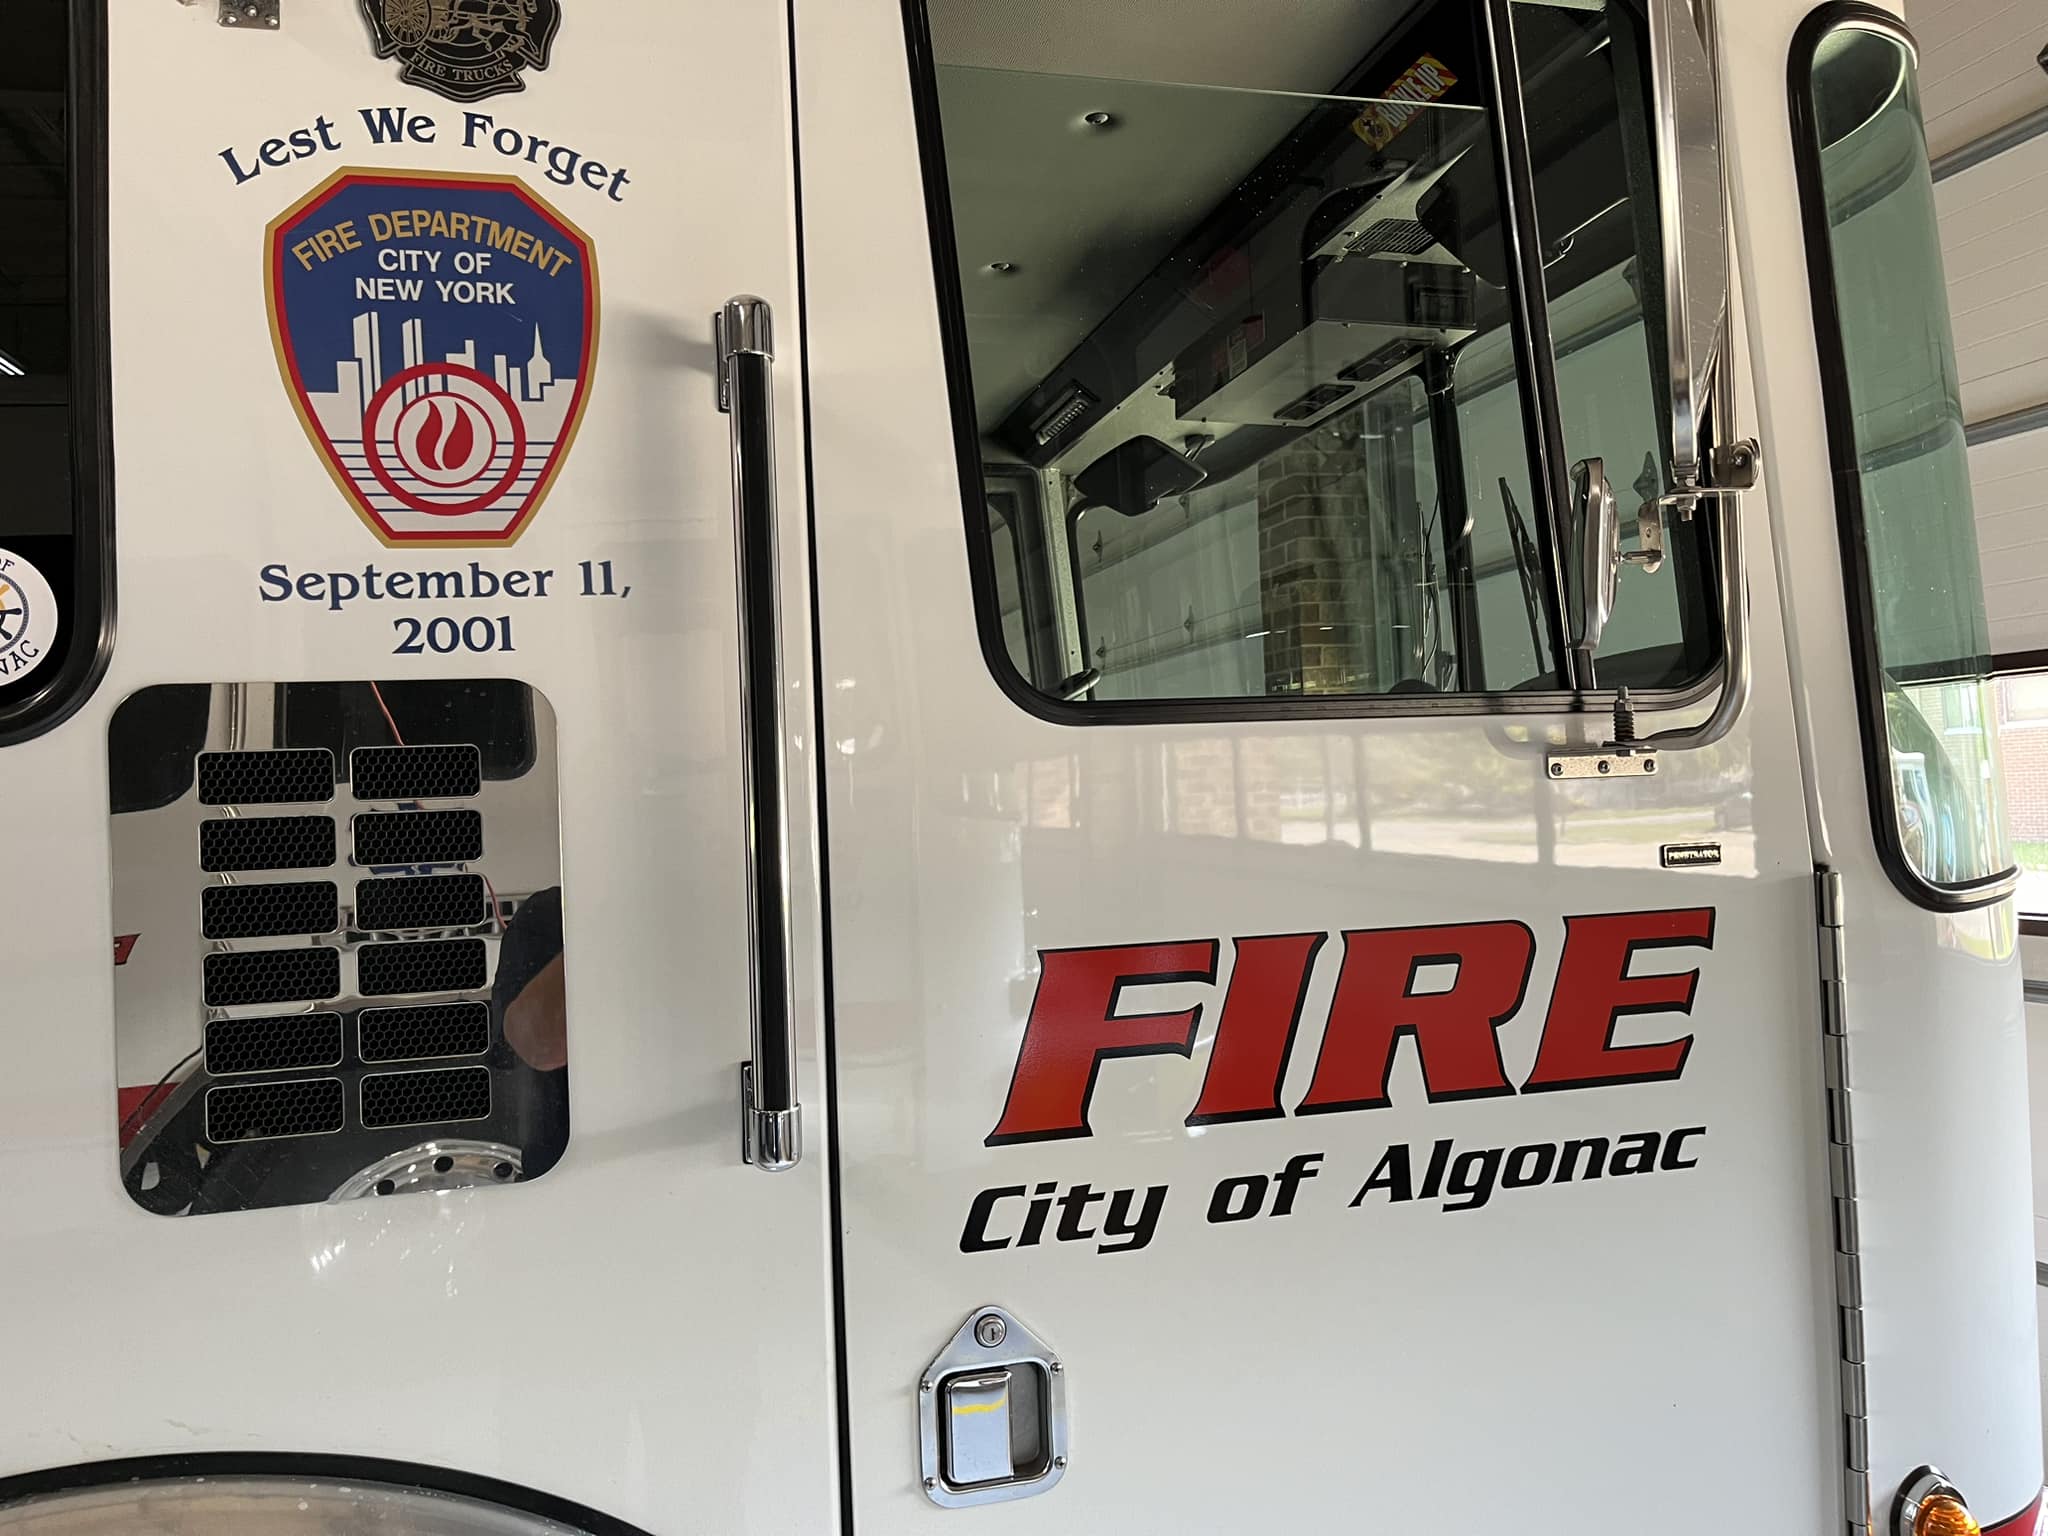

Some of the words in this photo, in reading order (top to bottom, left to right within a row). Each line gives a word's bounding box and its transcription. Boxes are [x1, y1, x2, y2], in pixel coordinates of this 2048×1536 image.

[410, 52, 446, 77] FIRE
[452, 59, 513, 82] TRUCKS
[1414, 63, 1446, 91] UP
[218, 115, 341, 185] Lest
[357, 107, 436, 144] We
[462, 111, 631, 202] Forget
[291, 219, 363, 271] FIRE
[368, 209, 573, 277] DEPARTMENT
[377, 248, 442, 273] CITY
[453, 251, 492, 275] OF
[355, 277, 424, 301] NEW
[435, 280, 516, 305] YORK
[259, 562, 554, 611] September
[578, 560, 632, 598] 11,
[391, 615, 516, 654] 2001
[984, 907, 1716, 1147] FIRE
[959, 1181, 1169, 1255] City
[1206, 1152, 1325, 1224] of
[1347, 1126, 1707, 1213] Algonac
